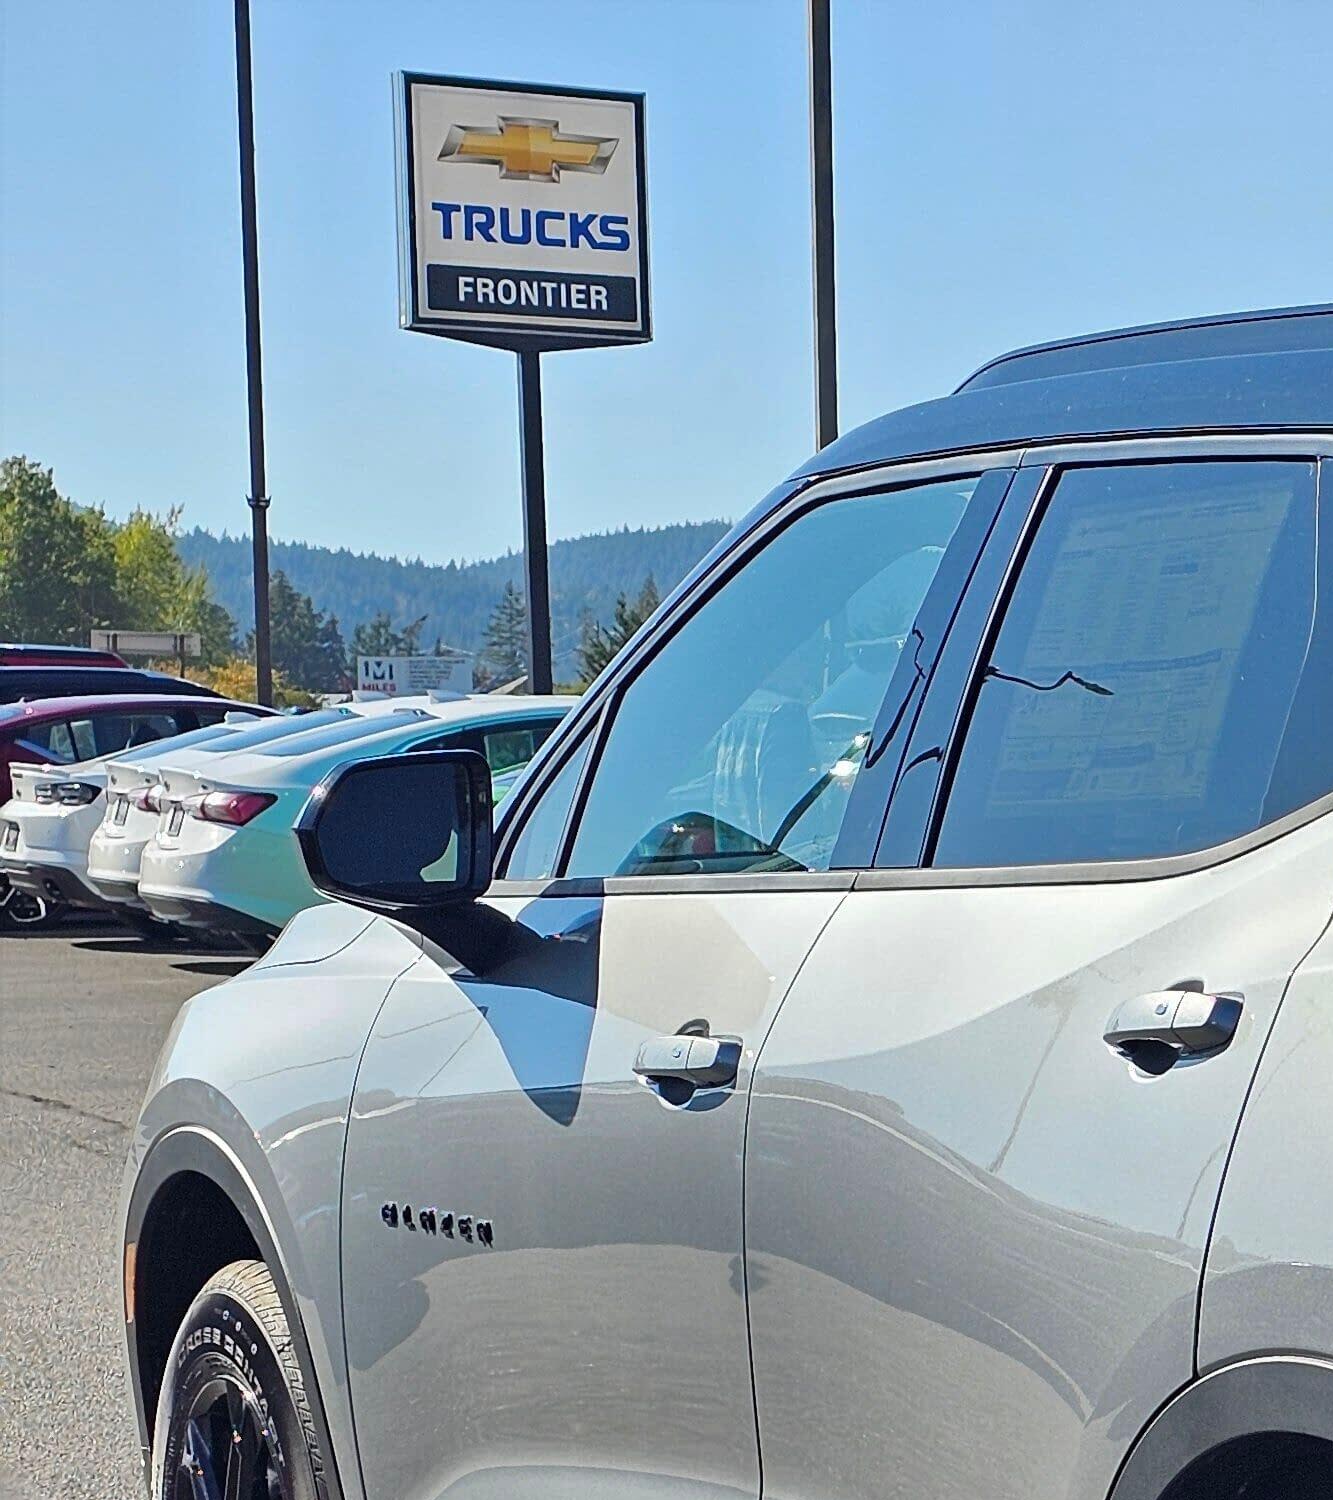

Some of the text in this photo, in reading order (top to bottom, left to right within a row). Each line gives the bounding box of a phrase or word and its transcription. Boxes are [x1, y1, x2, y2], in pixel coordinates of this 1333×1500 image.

[431, 202, 630, 251] TRUCKS
[457, 276, 608, 311] FRONTIER
[362, 683, 396, 692] MILES
[381, 1203, 493, 1249] BLAZER
[178, 1327, 221, 1368] CROSS
